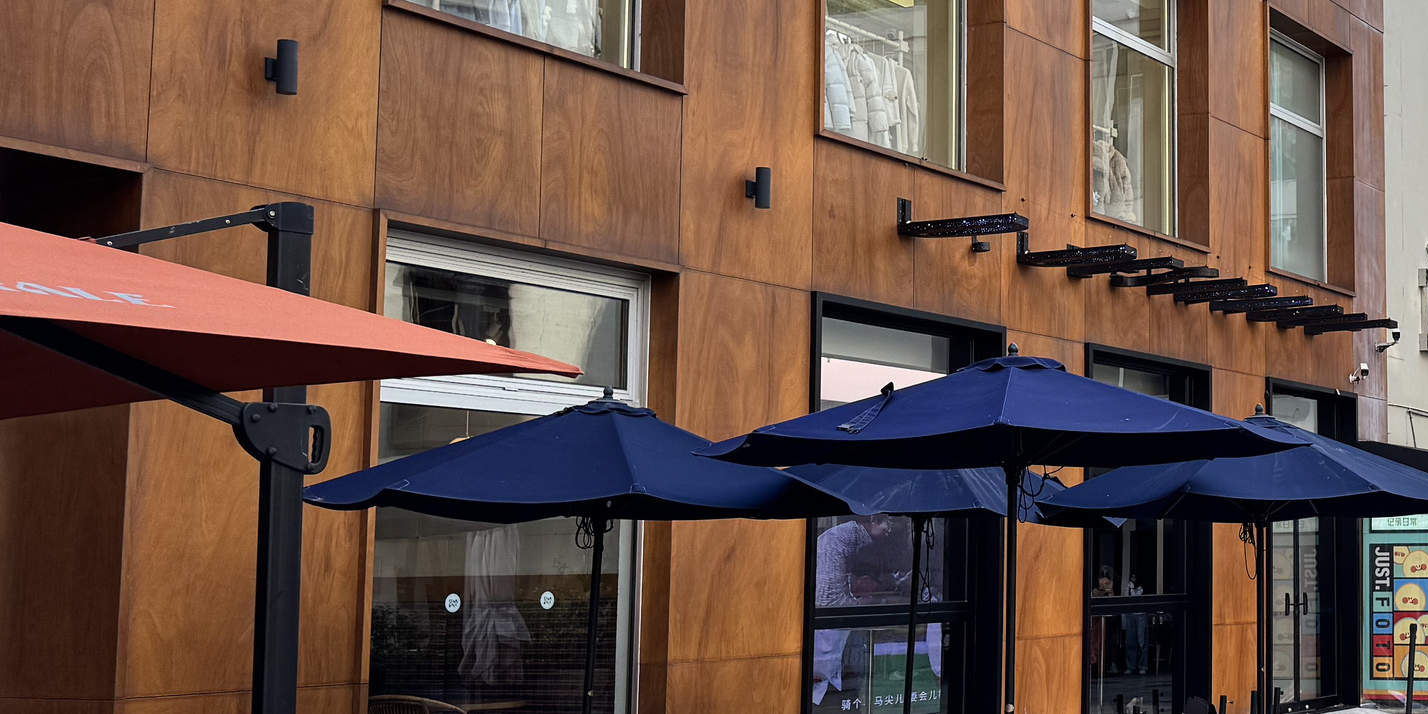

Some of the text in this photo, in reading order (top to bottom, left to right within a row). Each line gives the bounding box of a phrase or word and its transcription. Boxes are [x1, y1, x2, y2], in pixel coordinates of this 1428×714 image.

[0, 282, 177, 308] ALE
[1374, 547, 1391, 673] JUST. FOTO
